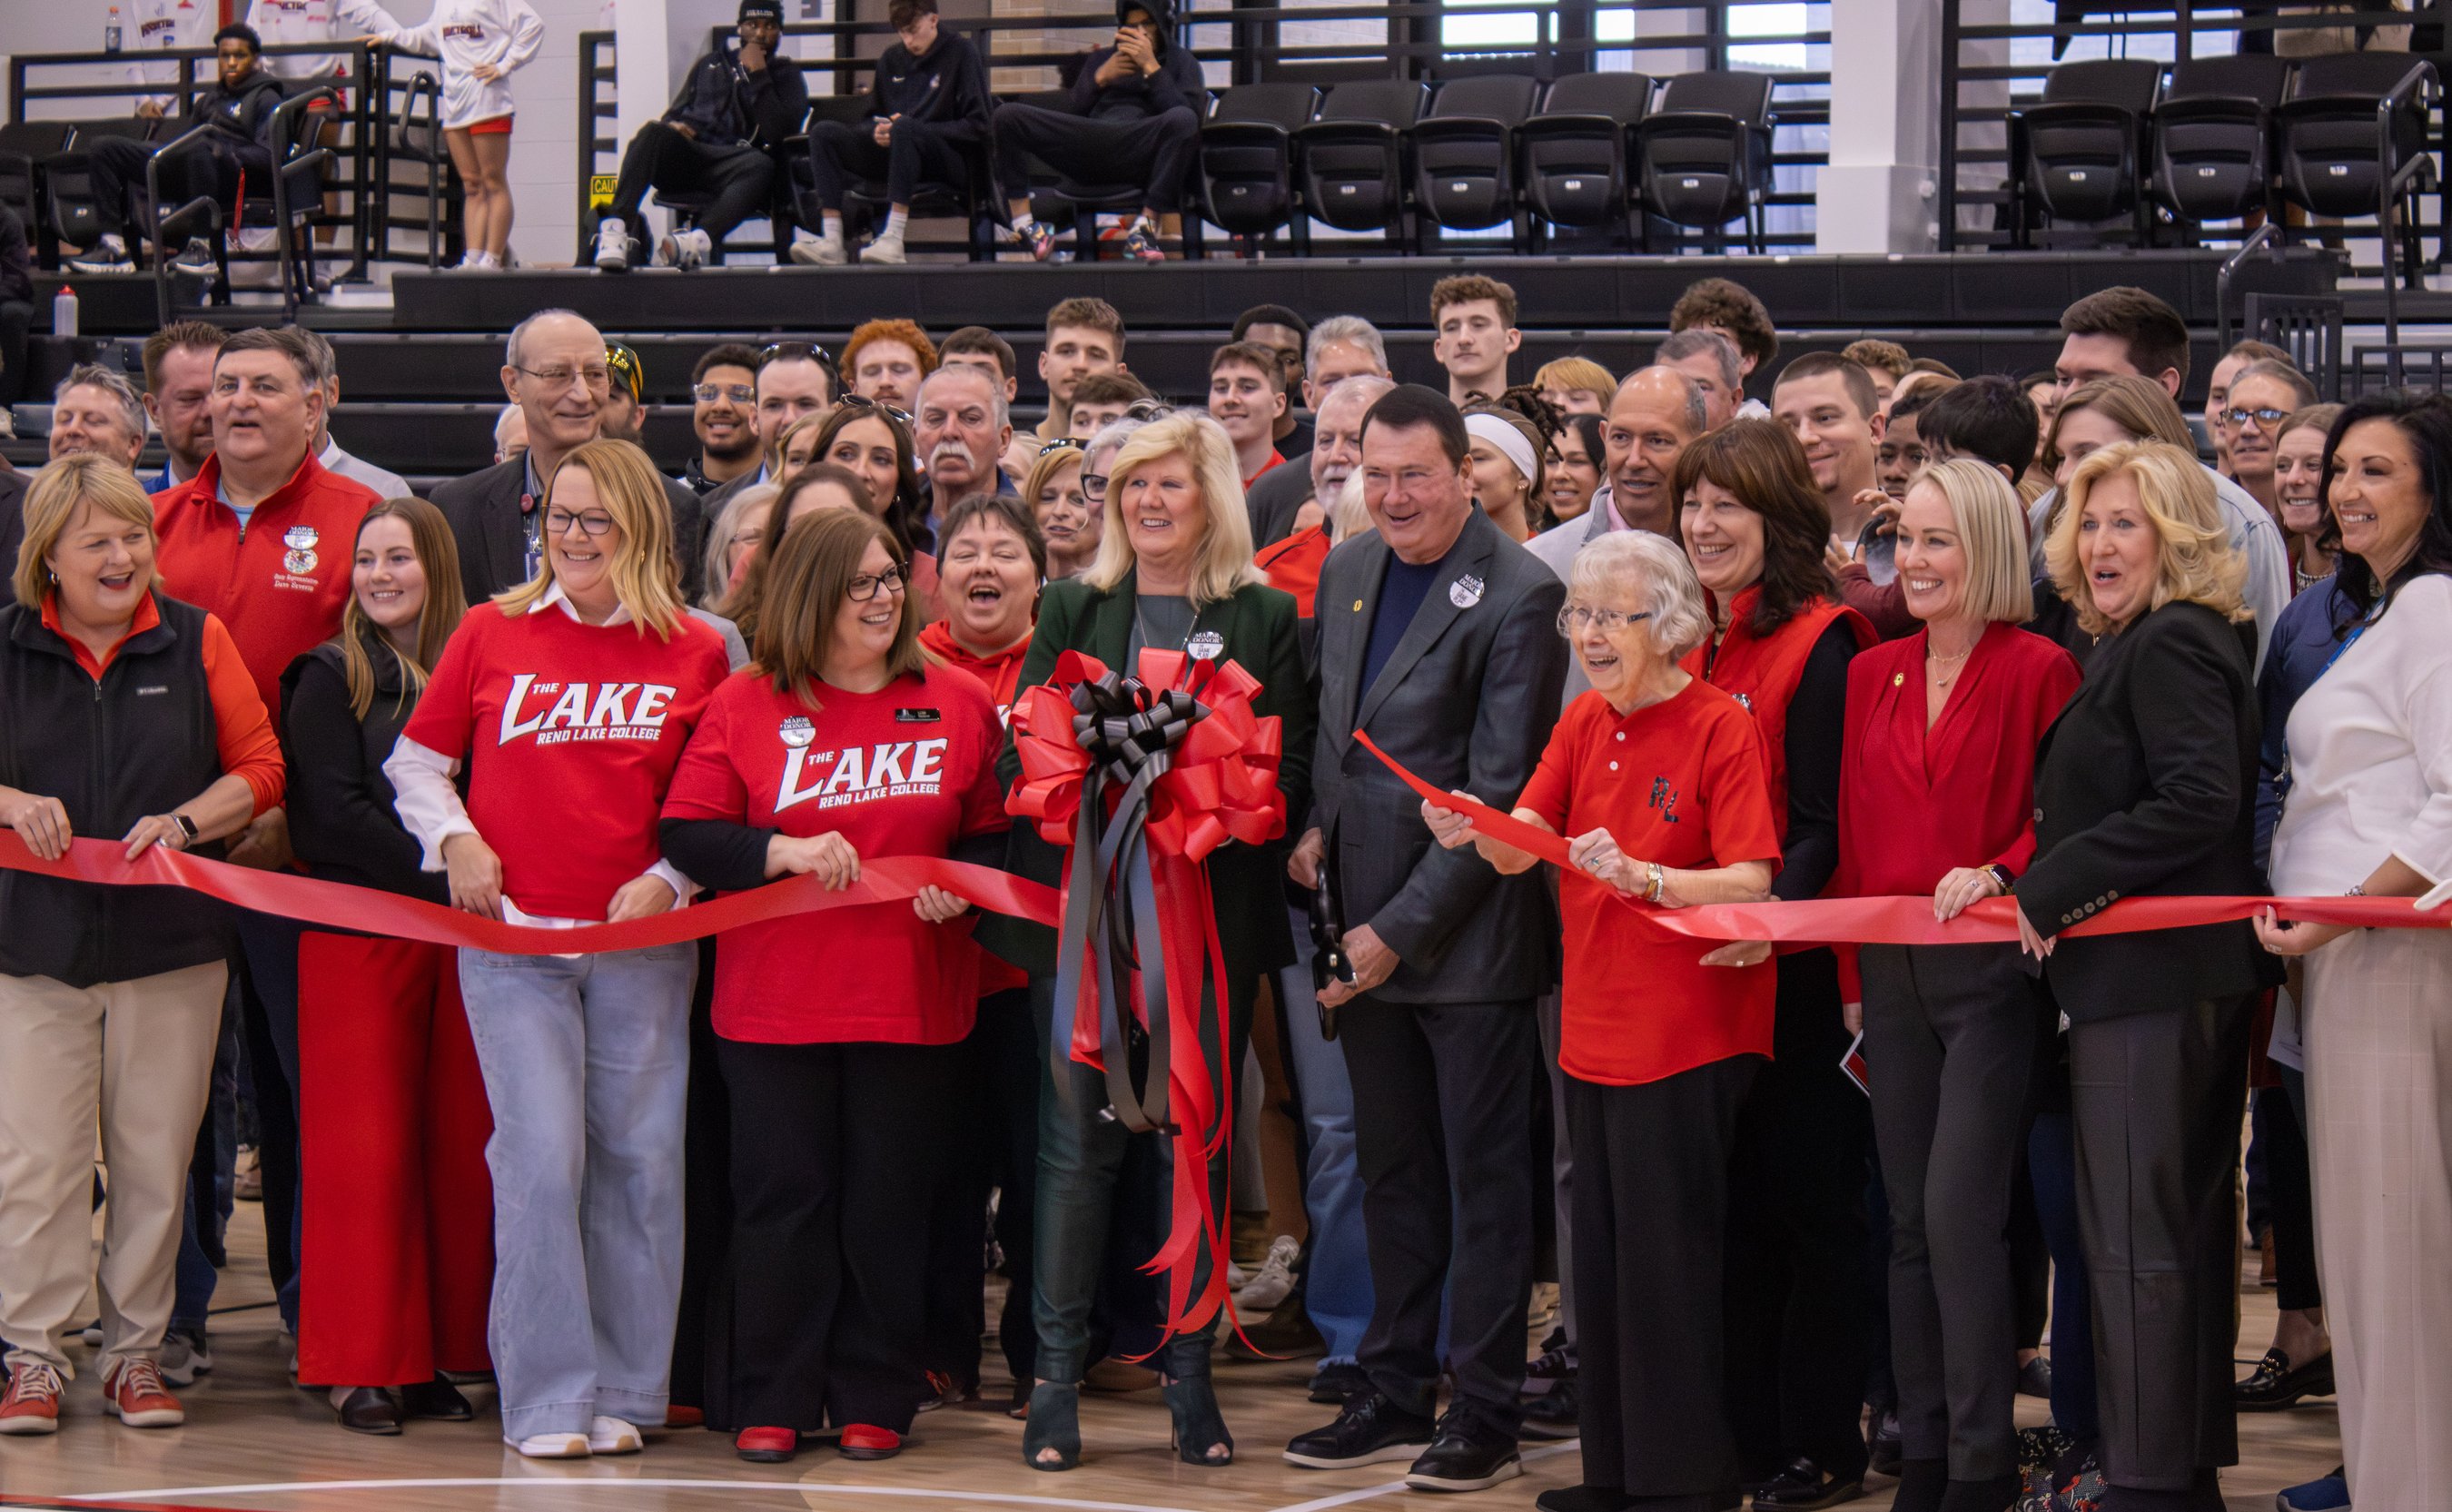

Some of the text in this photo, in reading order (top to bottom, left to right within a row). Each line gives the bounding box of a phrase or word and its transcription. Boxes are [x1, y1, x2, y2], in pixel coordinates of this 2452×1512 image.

[532, 683, 559, 695] THE
[499, 673, 678, 747] LAKE
[536, 727, 661, 746] REND LAKE COLLEGE
[808, 751, 835, 765] THE
[774, 737, 949, 814] LAKE
[818, 784, 941, 809] REND LAKE COLLEGE
